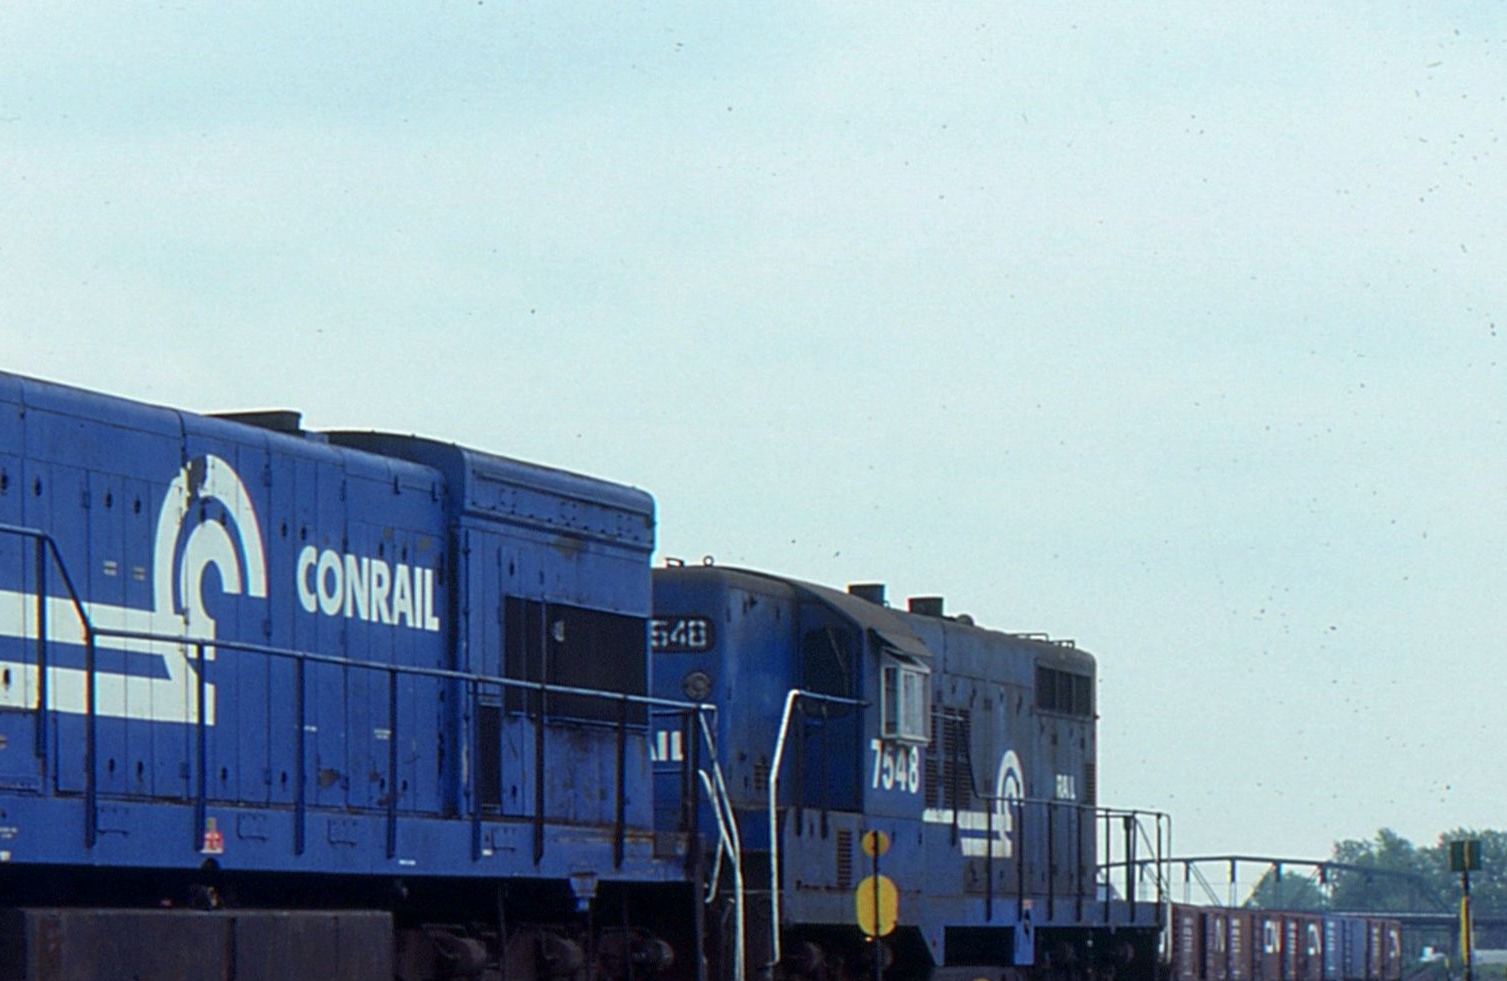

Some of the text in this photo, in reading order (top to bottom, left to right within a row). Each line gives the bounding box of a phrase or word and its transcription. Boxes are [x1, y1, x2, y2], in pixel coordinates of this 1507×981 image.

[297, 545, 440, 632] CONRAIL
[650, 620, 707, 647] 548
[871, 739, 920, 793] 7548
